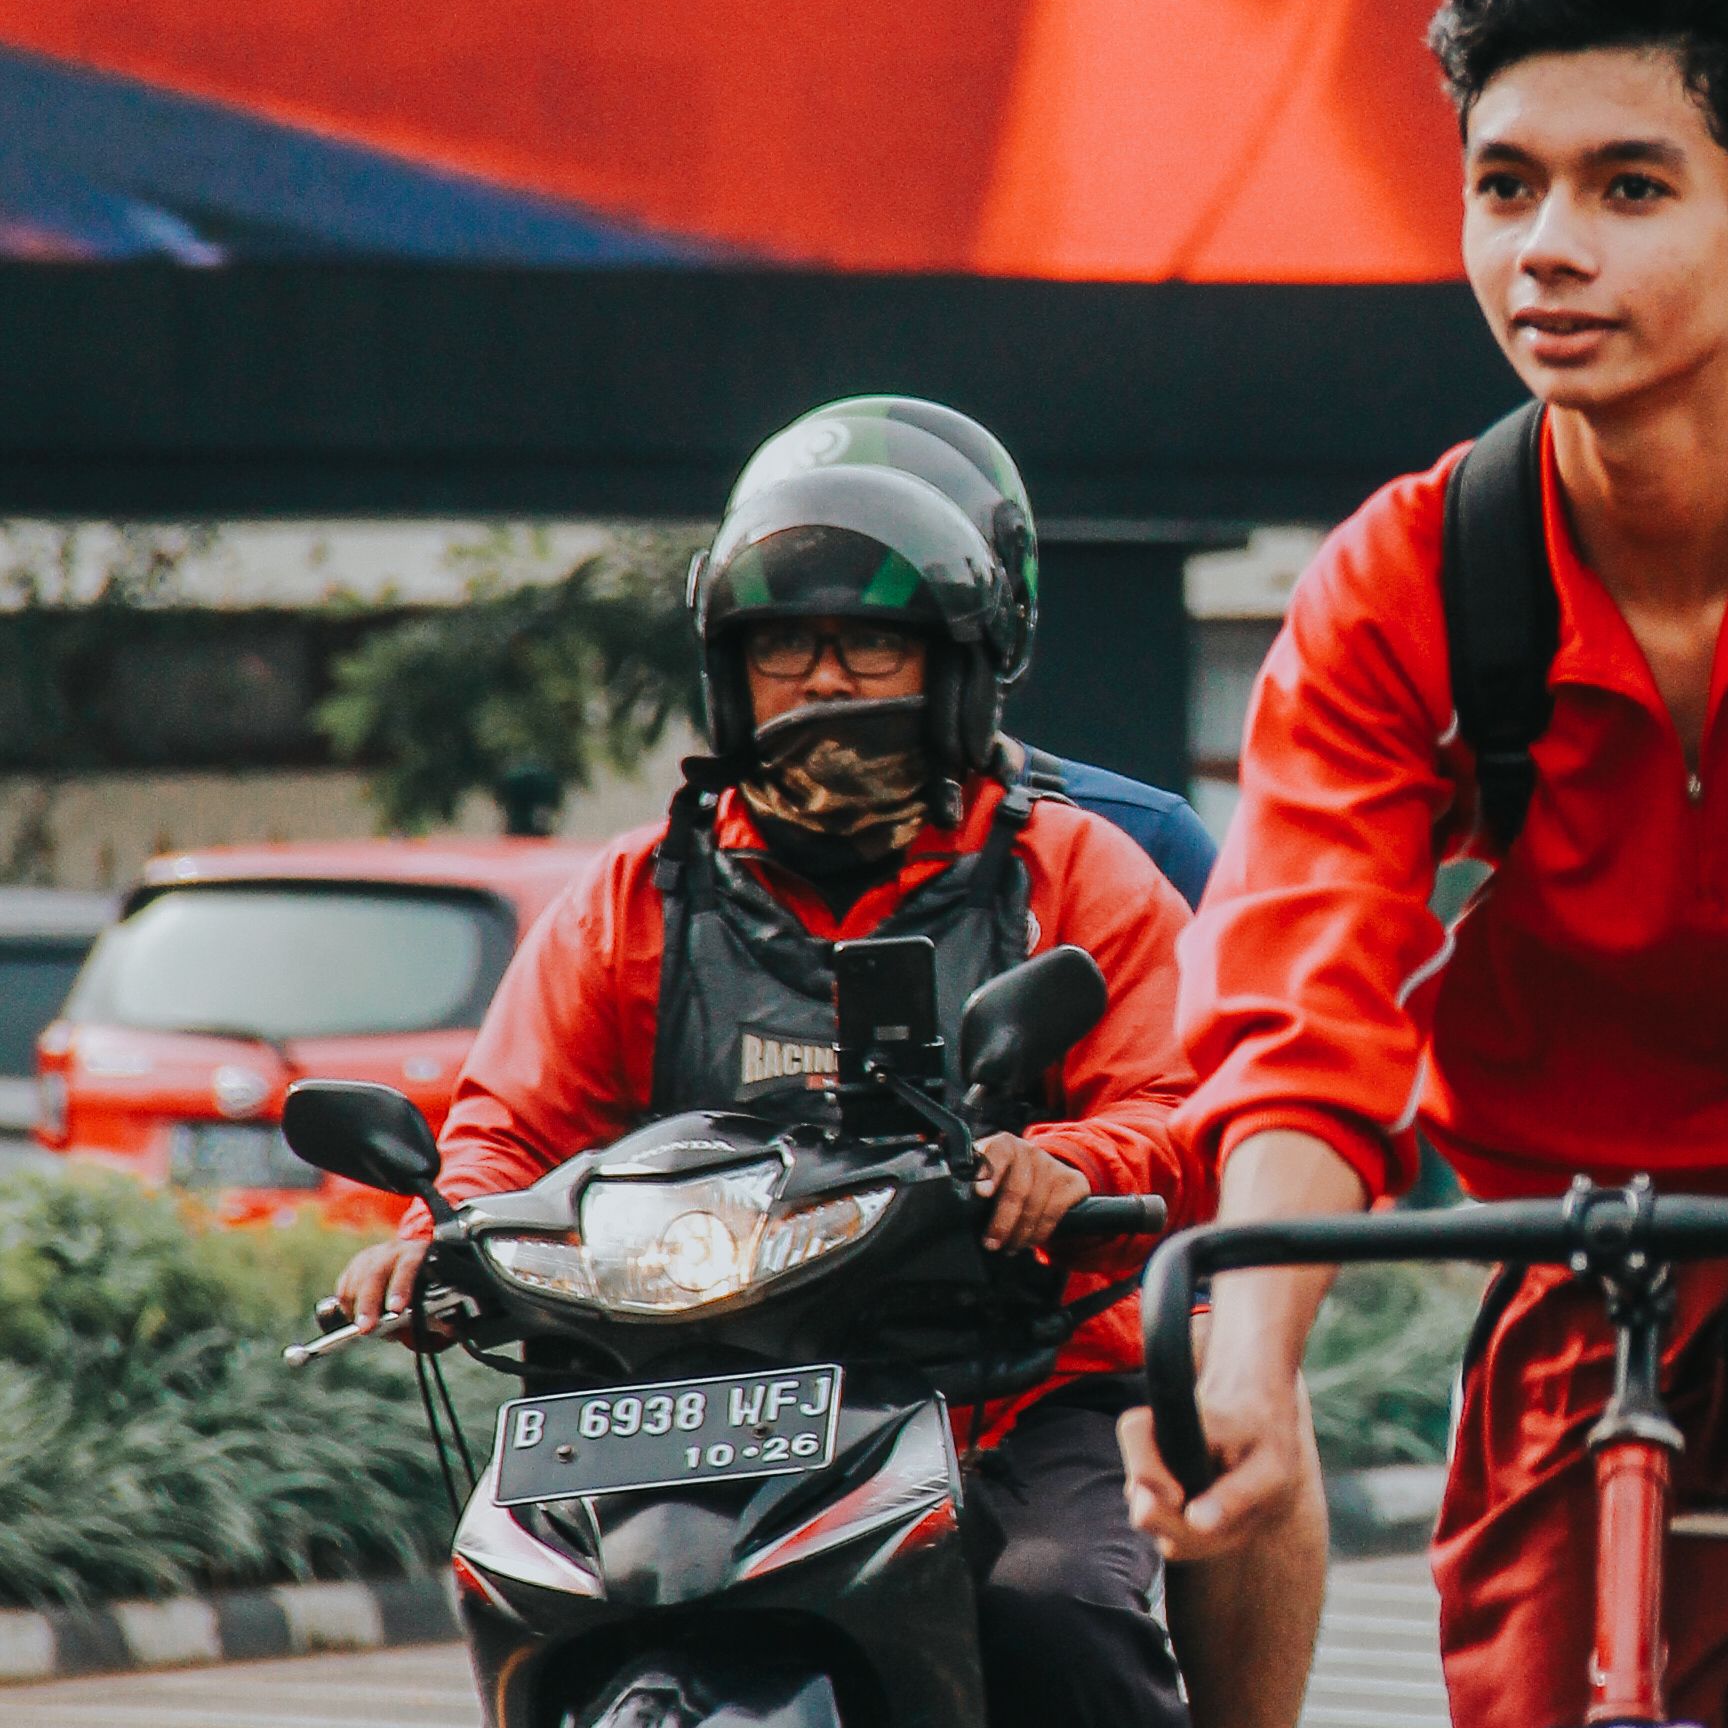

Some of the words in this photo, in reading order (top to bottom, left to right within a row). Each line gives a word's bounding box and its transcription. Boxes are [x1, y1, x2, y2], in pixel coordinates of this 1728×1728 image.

[742, 1033, 839, 1086] RACIN
[512, 1409, 546, 1449] B
[578, 1391, 707, 1439] 6938
[727, 1376, 832, 1428] WFJ
